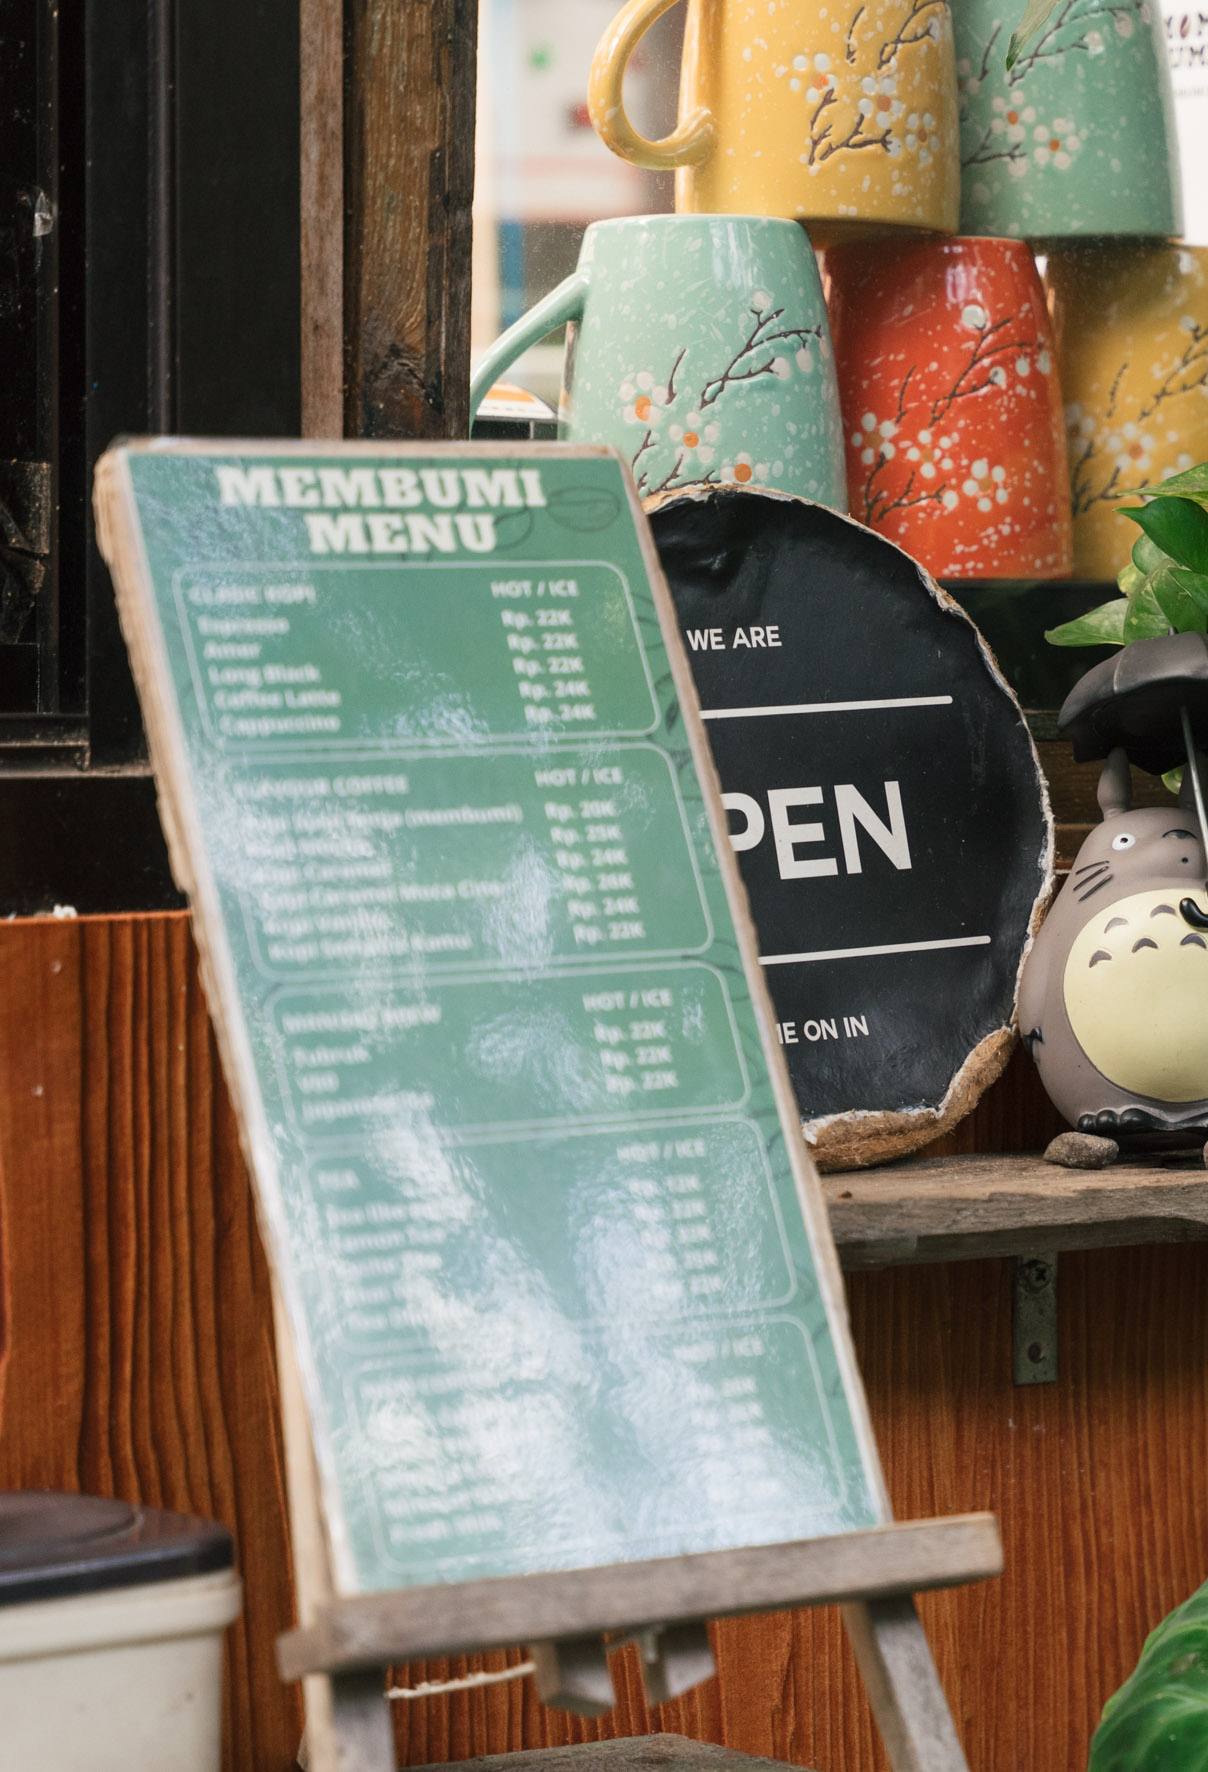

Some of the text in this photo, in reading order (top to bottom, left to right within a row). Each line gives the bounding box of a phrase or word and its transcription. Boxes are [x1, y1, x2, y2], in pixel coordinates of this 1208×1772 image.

[215, 466, 547, 508] MEMBUMI
[305, 513, 498, 554] MENU
[490, 580, 532, 598] HOT
[548, 580, 579, 597] ICE
[535, 609, 573, 626] 22K
[541, 632, 579, 650] 22K
[687, 625, 782, 652] WE ARE
[547, 656, 584, 673] 22K
[553, 679, 591, 698] 24K
[535, 768, 576, 788] HOT
[593, 766, 624, 785] ICE
[719, 780, 912, 880] PEN
[582, 991, 625, 1012] HOT
[640, 988, 673, 1008] ICE
[804, 1018, 839, 1042] ON
[843, 1015, 869, 1039] IN
